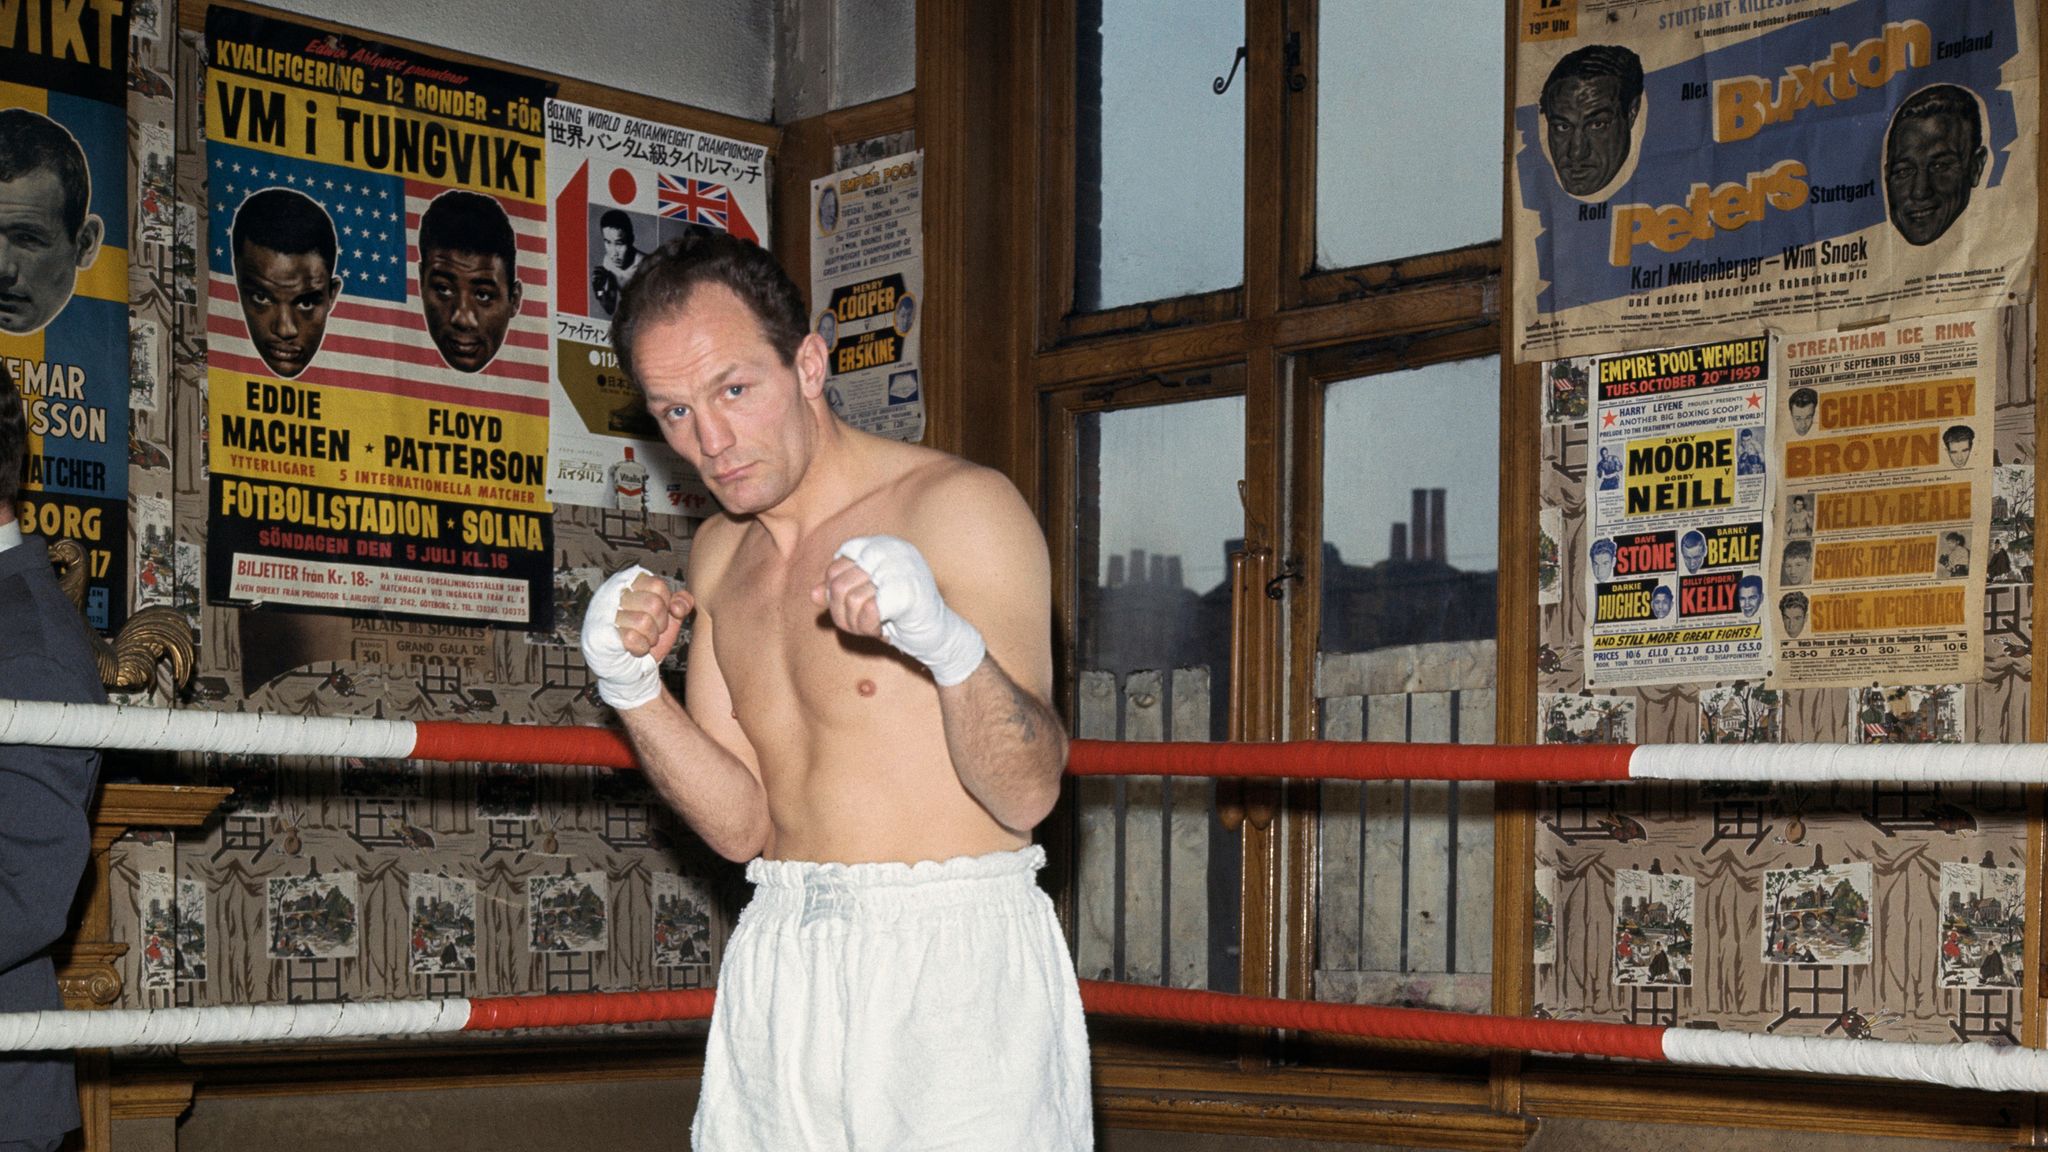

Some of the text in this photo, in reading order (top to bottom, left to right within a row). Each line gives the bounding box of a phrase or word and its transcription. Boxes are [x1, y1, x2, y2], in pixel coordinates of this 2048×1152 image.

[1659, 1, 1731, 30] STUTTGART
[1937, 31, 1994, 60] England
[217, 40, 542, 133] KVALIFICERING 12 RONDER FÖR
[1681, 82, 1708, 101] Alex
[1713, 19, 1932, 144] Buxton
[216, 80, 542, 199] VM i TUNGVIKT
[547, 101, 763, 163] BOXING WORLD BANTAMWEIGHT CHAMPIONSHIP
[548, 122, 763, 184] 世界バンタム級タイトルマッチ
[1810, 179, 1876, 204] Stuttgart
[1578, 203, 1608, 221] Rolf
[1631, 236, 1868, 290] Karl Mildenberger Wim Snoek
[838, 286, 896, 322] COOPER
[1628, 270, 1868, 307] und andere bedeutende Rahmenkämpfe
[838, 337, 896, 373] ERSKINE
[1787, 331, 1886, 359] STREATHAM
[1897, 327, 1924, 345] ICE
[1935, 321, 1976, 341] RINK
[1601, 338, 1767, 384] EMPIRE POOL WEMBLEY
[1730, 365, 1761, 382] 1959
[1789, 363, 1826, 379] TUESDAY
[1844, 355, 1896, 371] SEPTEMBER
[1900, 352, 1920, 365] 1959
[2, 357, 86, 401] EMAR
[246, 381, 321, 420] EDDIE
[1619, 406, 1646, 418] HARRY
[1653, 401, 1683, 413] LEVENE
[1821, 383, 1975, 430] CHARNLEY
[428, 408, 503, 443] FLOYD
[1600, 429, 1623, 438] PRELUDE
[1632, 427, 1642, 435] THE
[1676, 418, 1718, 430] CHAMPIONSHIP
[1728, 414, 1738, 422] THE
[1620, 415, 1657, 427] ANOTHER
[1660, 413, 1674, 422] BIG
[1677, 409, 1709, 420] BOXING
[221, 414, 350, 462] MACHEN
[1665, 435, 1696, 445] DAVEY
[384, 434, 544, 486] PATTERSON
[1629, 438, 1733, 476] MOORE
[1786, 432, 1939, 479] BROWN
[229, 454, 536, 504] YTTERLIGARE 5 INTERNATIONELLA MATCHER
[1664, 473, 1695, 482] BOBBY
[1628, 477, 1731, 514] NEILL
[1817, 494, 1888, 530] KELLY
[1900, 487, 1971, 522] BEALE
[21, 501, 103, 541] BORG
[221, 479, 544, 551] FOTBOLLSTADION SOLNA
[1717, 526, 1748, 536] BARNEY
[258, 527, 349, 555] SÖNDAGEN
[356, 540, 393, 558] DEN
[406, 544, 417, 560] 5
[420, 545, 456, 566] JULI
[1634, 535, 1656, 544] DAVE
[1707, 535, 1760, 565] BEALE
[90, 549, 112, 578] 17
[237, 560, 299, 581] BILJETTER
[303, 567, 324, 584] från
[328, 569, 347, 585] Kr.
[1617, 542, 1676, 574] STONE
[1815, 546, 1864, 580] SPINKS
[1612, 583, 1641, 592] DARKIE
[1681, 583, 1737, 614] KELLY
[1598, 591, 1650, 620] HUGHES
[1812, 598, 1864, 632] STONE
[396, 640, 434, 654] GRAND
[439, 643, 468, 655] GALA
[472, 645, 486, 656] DE
[1594, 637, 1615, 647] AND
[1616, 635, 1645, 647] STILL
[1646, 633, 1679, 644] MORE
[1683, 630, 1712, 641] GREAT
[1593, 651, 1619, 661] PRICES
[1615, 659, 1628, 667] YOUR
[1633, 658, 1653, 666] TICKETS
[1715, 652, 1760, 661] DISAPPOINTMENT
